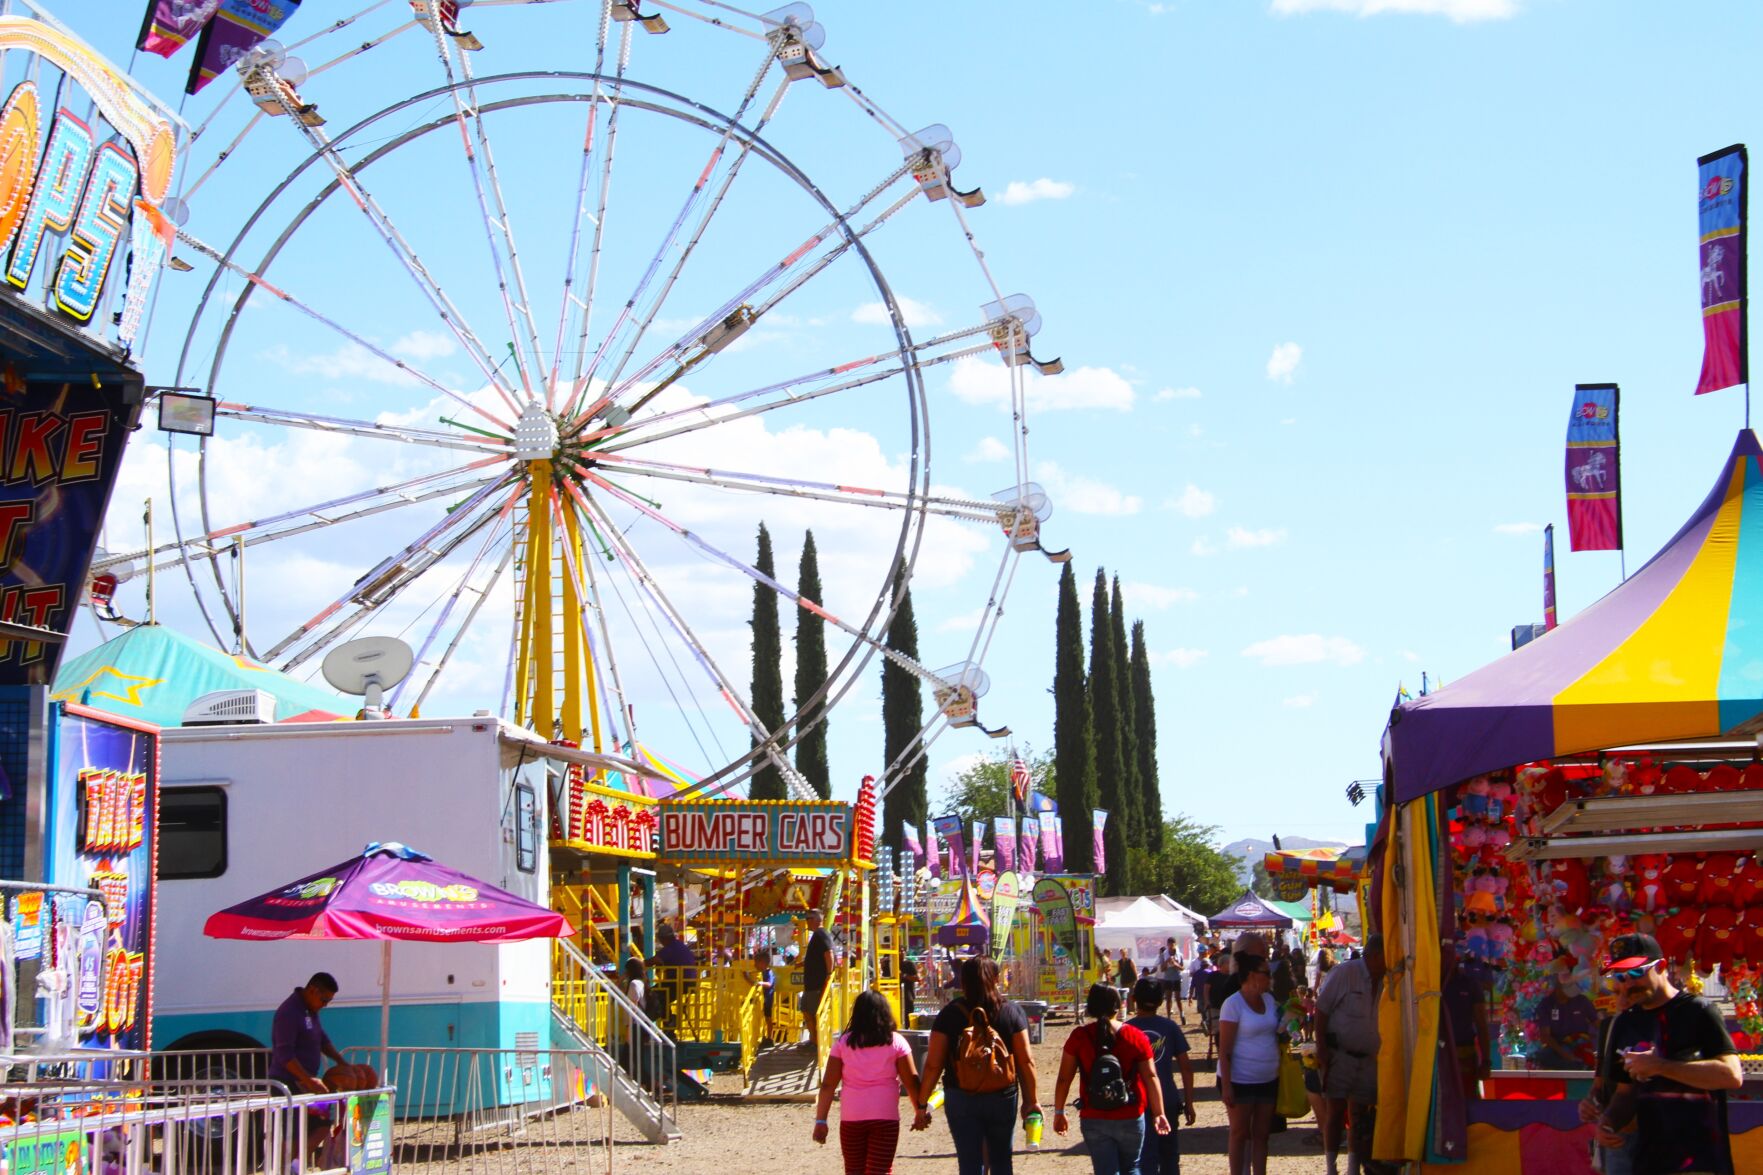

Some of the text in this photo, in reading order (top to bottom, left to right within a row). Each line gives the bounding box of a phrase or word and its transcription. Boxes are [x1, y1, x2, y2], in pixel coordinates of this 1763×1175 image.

[0, 410, 111, 488] KE
[664, 812, 846, 853] BUMPER CARS
[376, 899, 488, 910] AMUSEMENTS
[375, 923, 507, 936] brownsamusements.com
